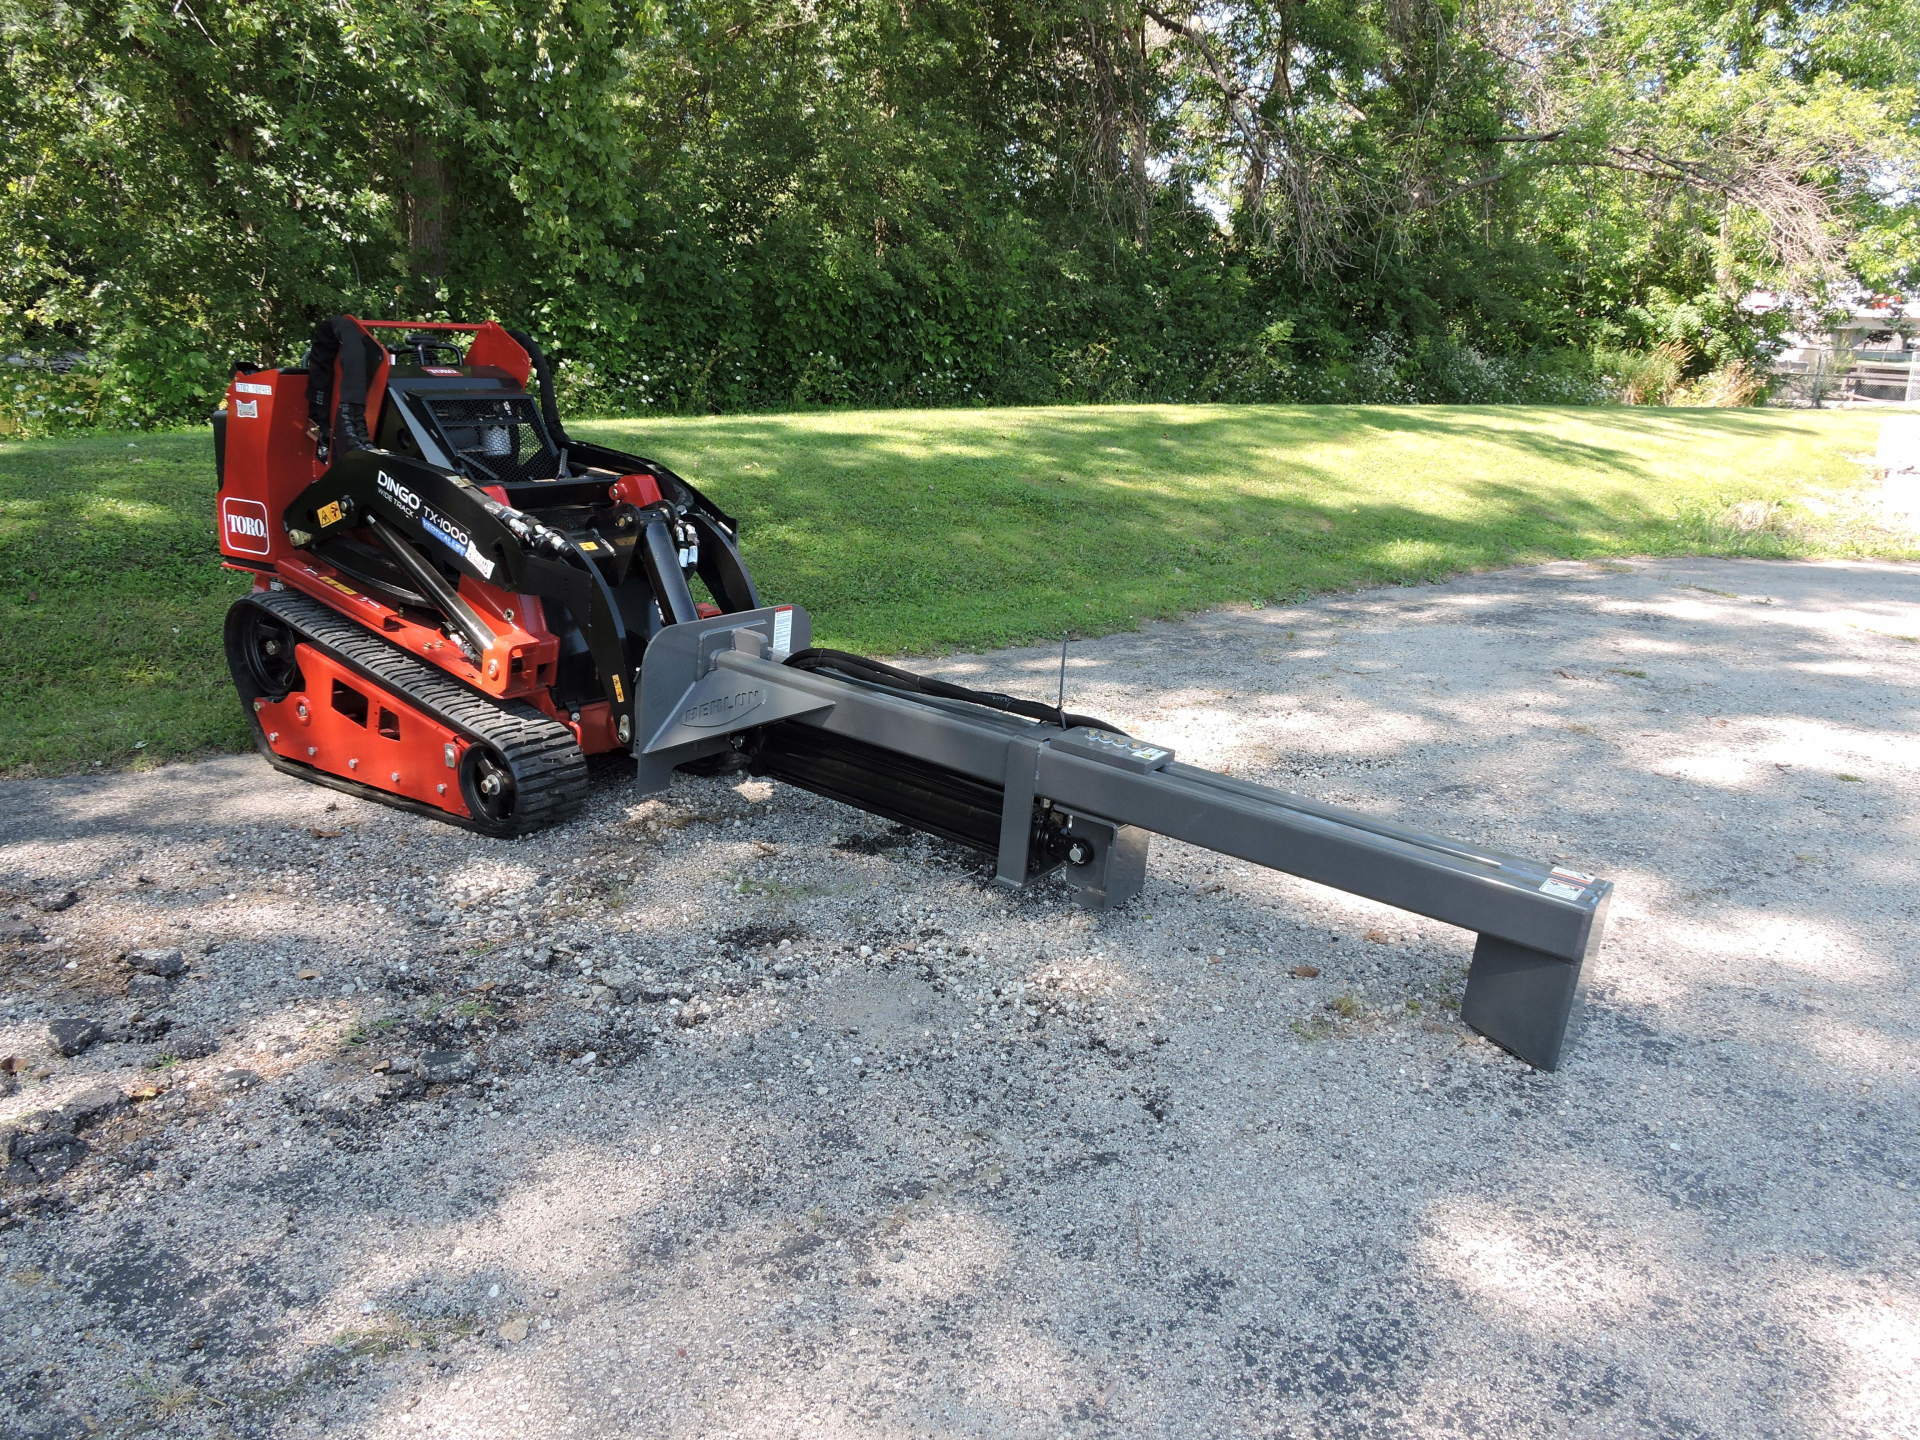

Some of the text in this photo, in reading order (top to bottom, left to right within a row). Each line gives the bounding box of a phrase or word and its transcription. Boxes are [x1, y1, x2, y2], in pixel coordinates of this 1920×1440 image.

[377, 470, 420, 510] DINGO
[377, 487, 414, 517] WIDE TRACK
[227, 514, 265, 537] TORO
